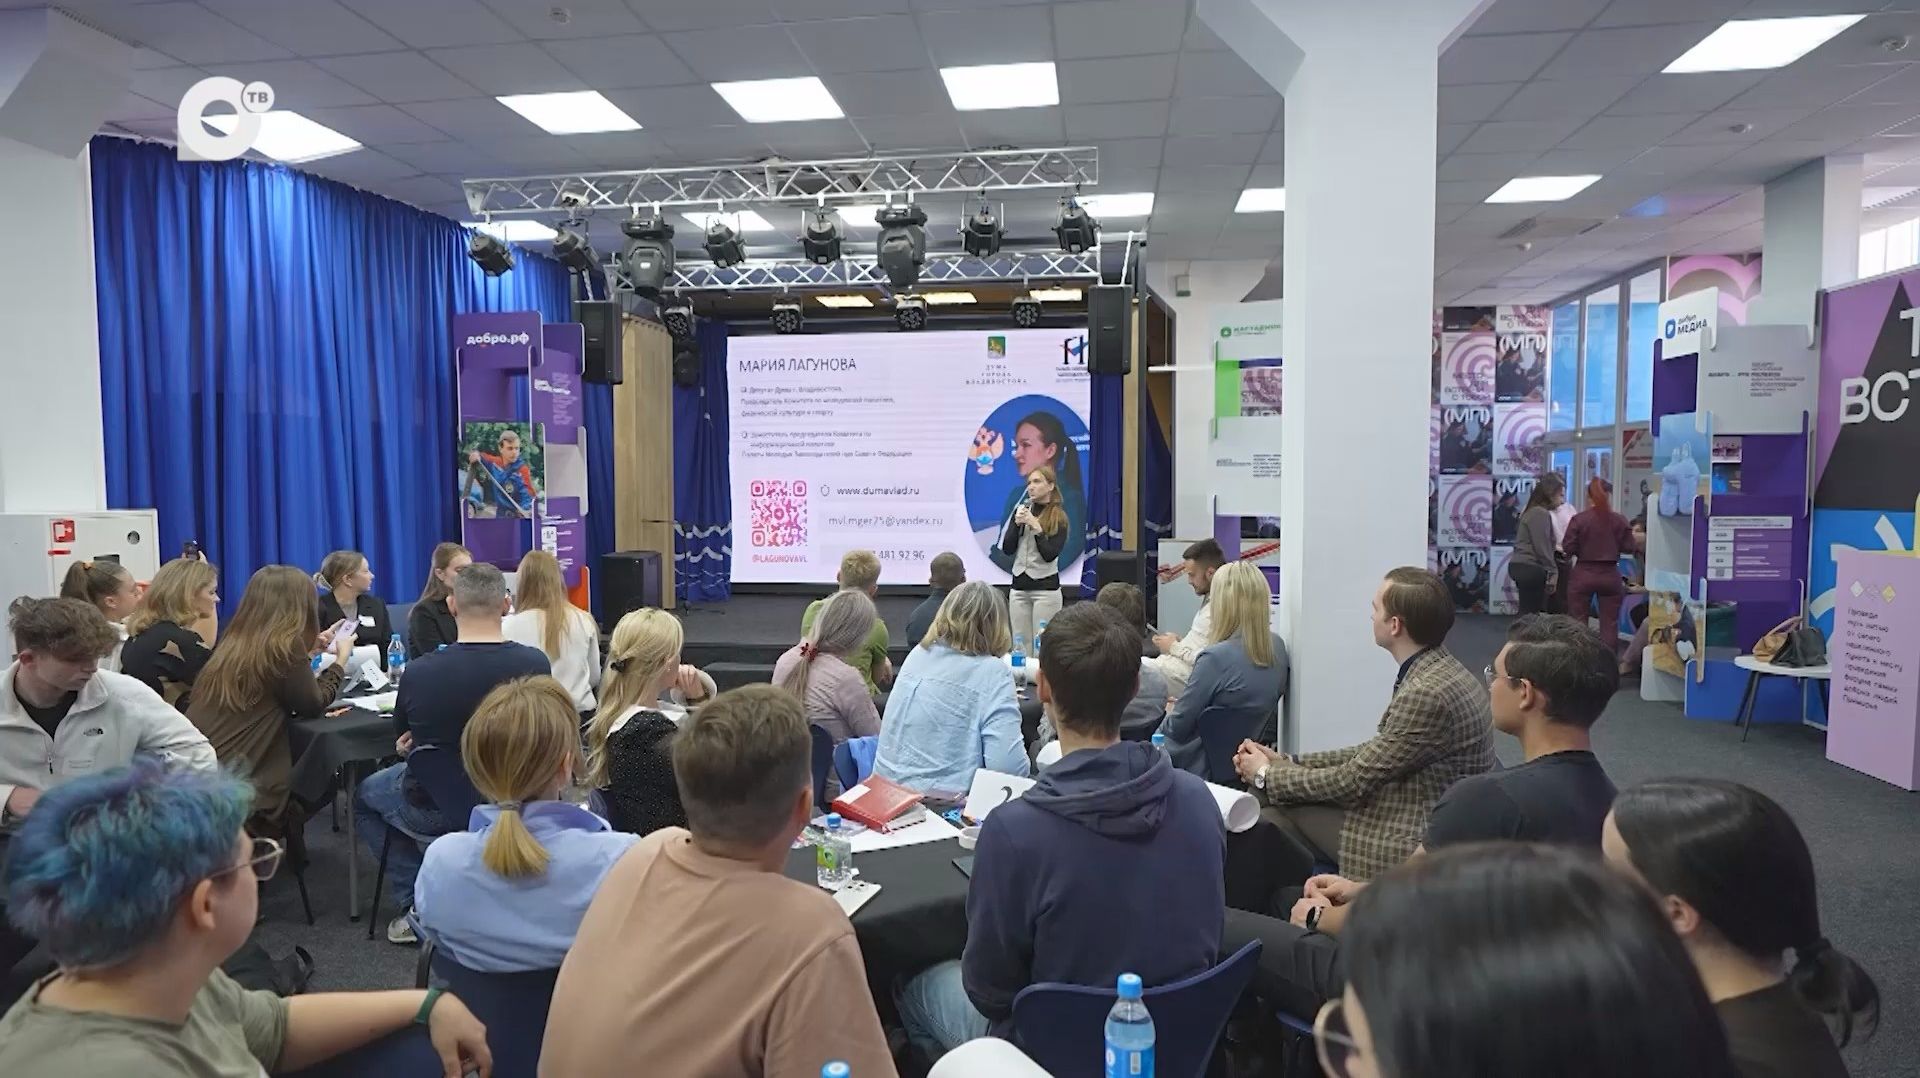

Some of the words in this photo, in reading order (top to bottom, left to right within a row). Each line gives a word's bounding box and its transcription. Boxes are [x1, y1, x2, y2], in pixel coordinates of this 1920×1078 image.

[1677, 318, 1707, 335] МЕДИА
[466, 332, 530, 345] добро.рф
[739, 359, 786, 373] МАРИЯ
[788, 358, 857, 371] ЛАГУНОВА
[836, 484, 920, 496] www.dumavlad.ru
